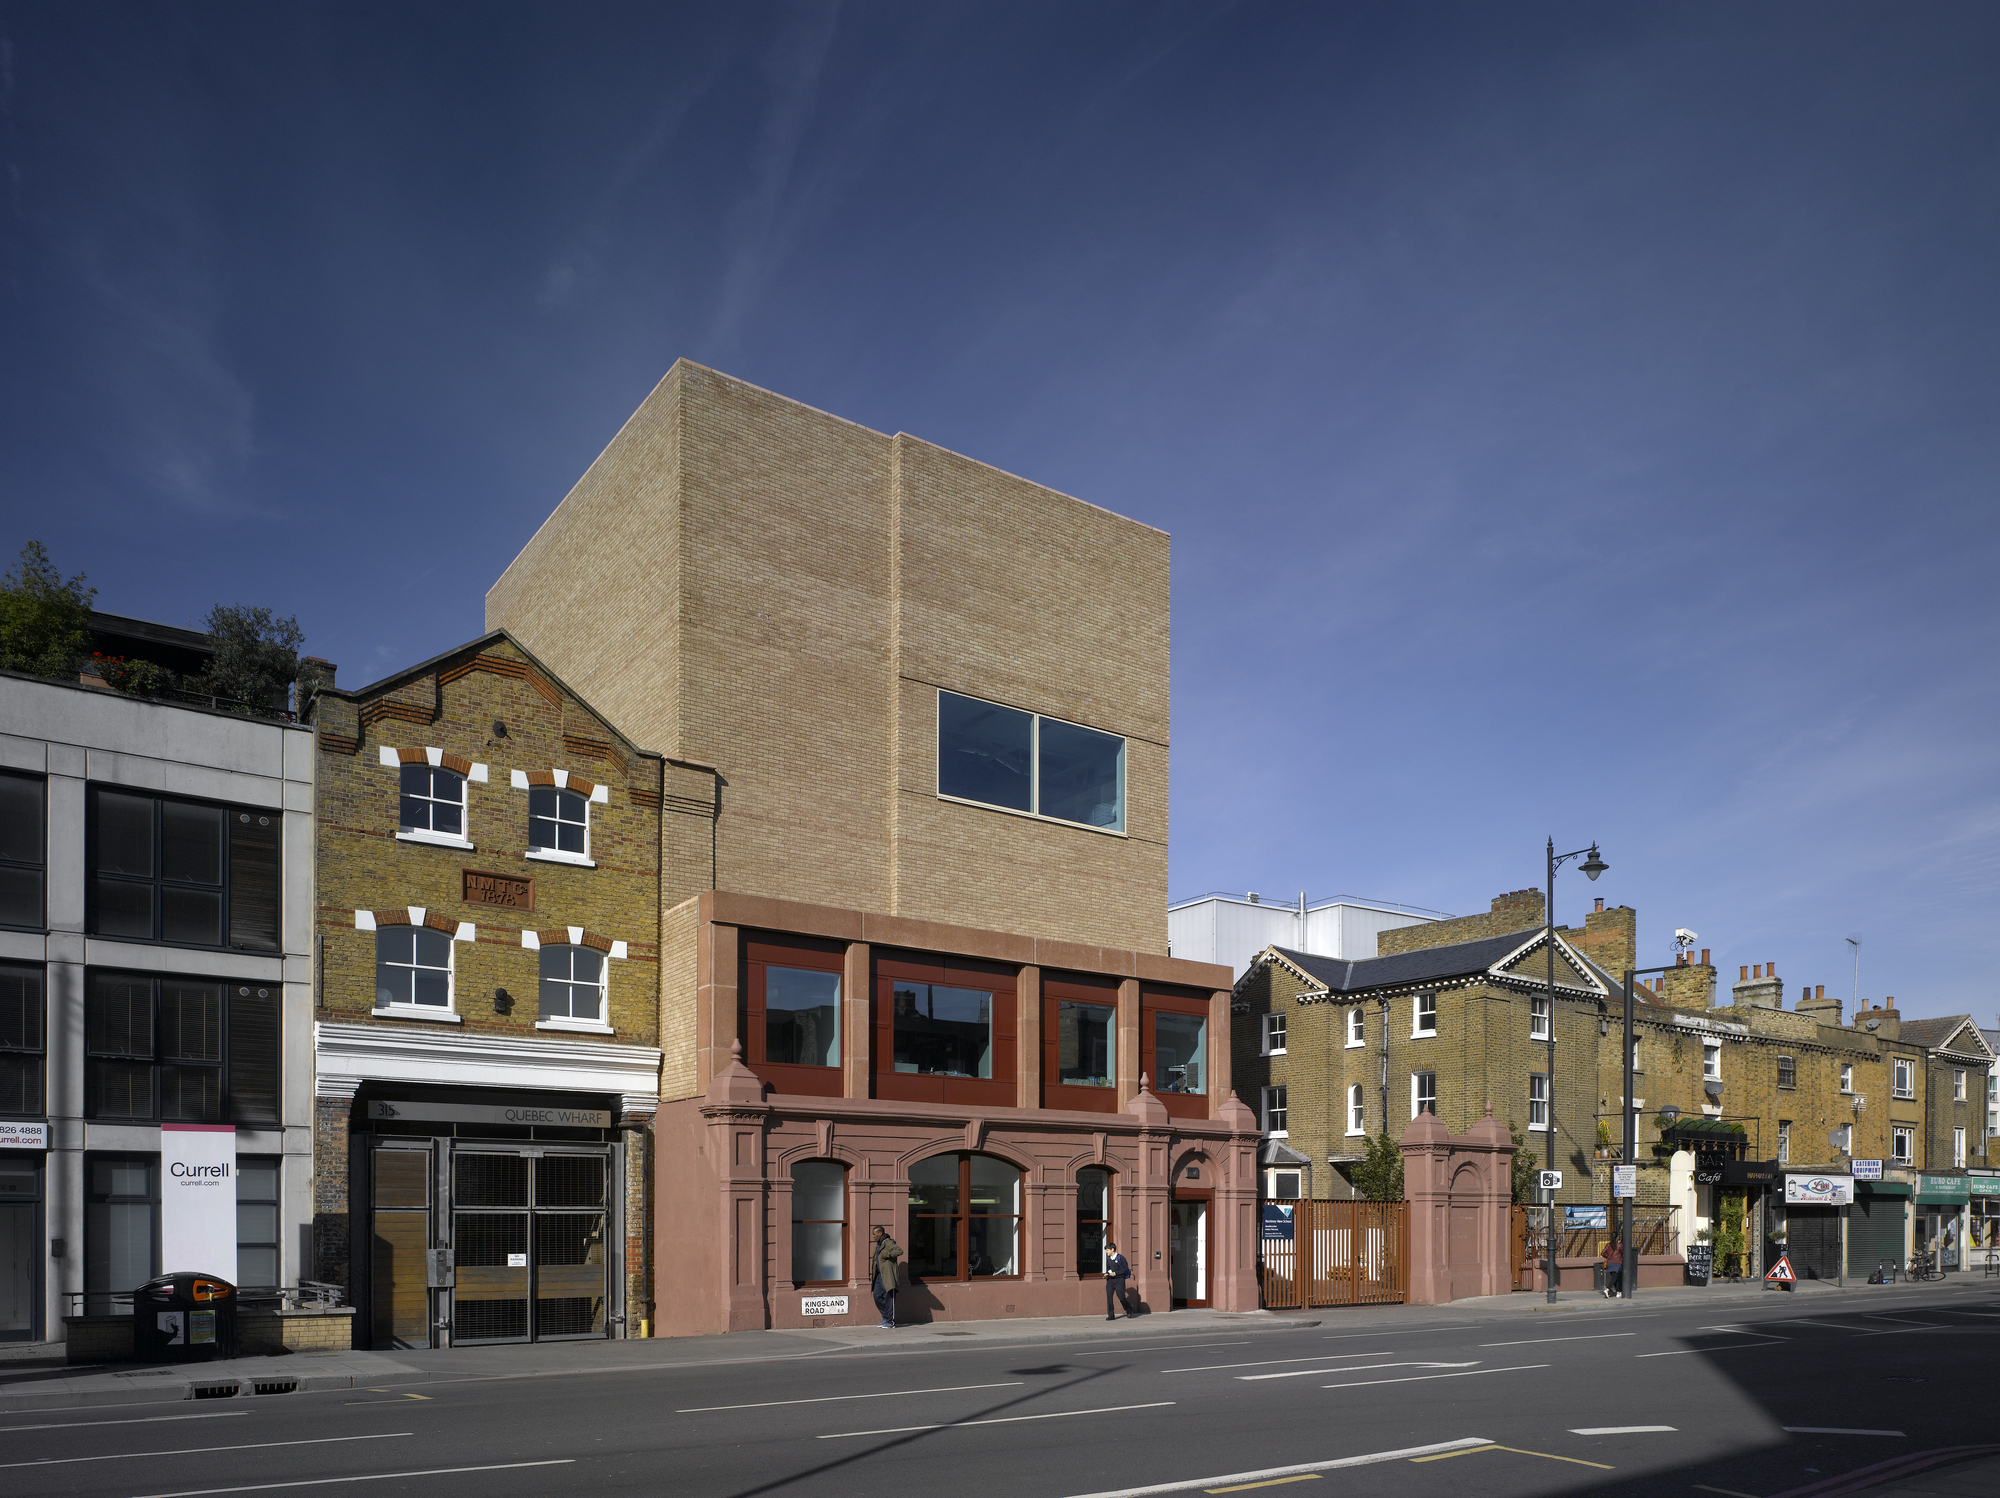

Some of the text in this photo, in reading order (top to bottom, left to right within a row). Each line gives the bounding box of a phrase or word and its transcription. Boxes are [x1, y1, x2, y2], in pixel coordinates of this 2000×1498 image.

[481, 890, 517, 906] 1878
[378, 1104, 602, 1124] 315 QUEBEC WHARF
[1696, 1154, 1724, 1166] BAR
[170, 1162, 229, 1177] Currell
[1698, 1172, 1722, 1184] Café
[1930, 1177, 1961, 1185] EURO CAFE
